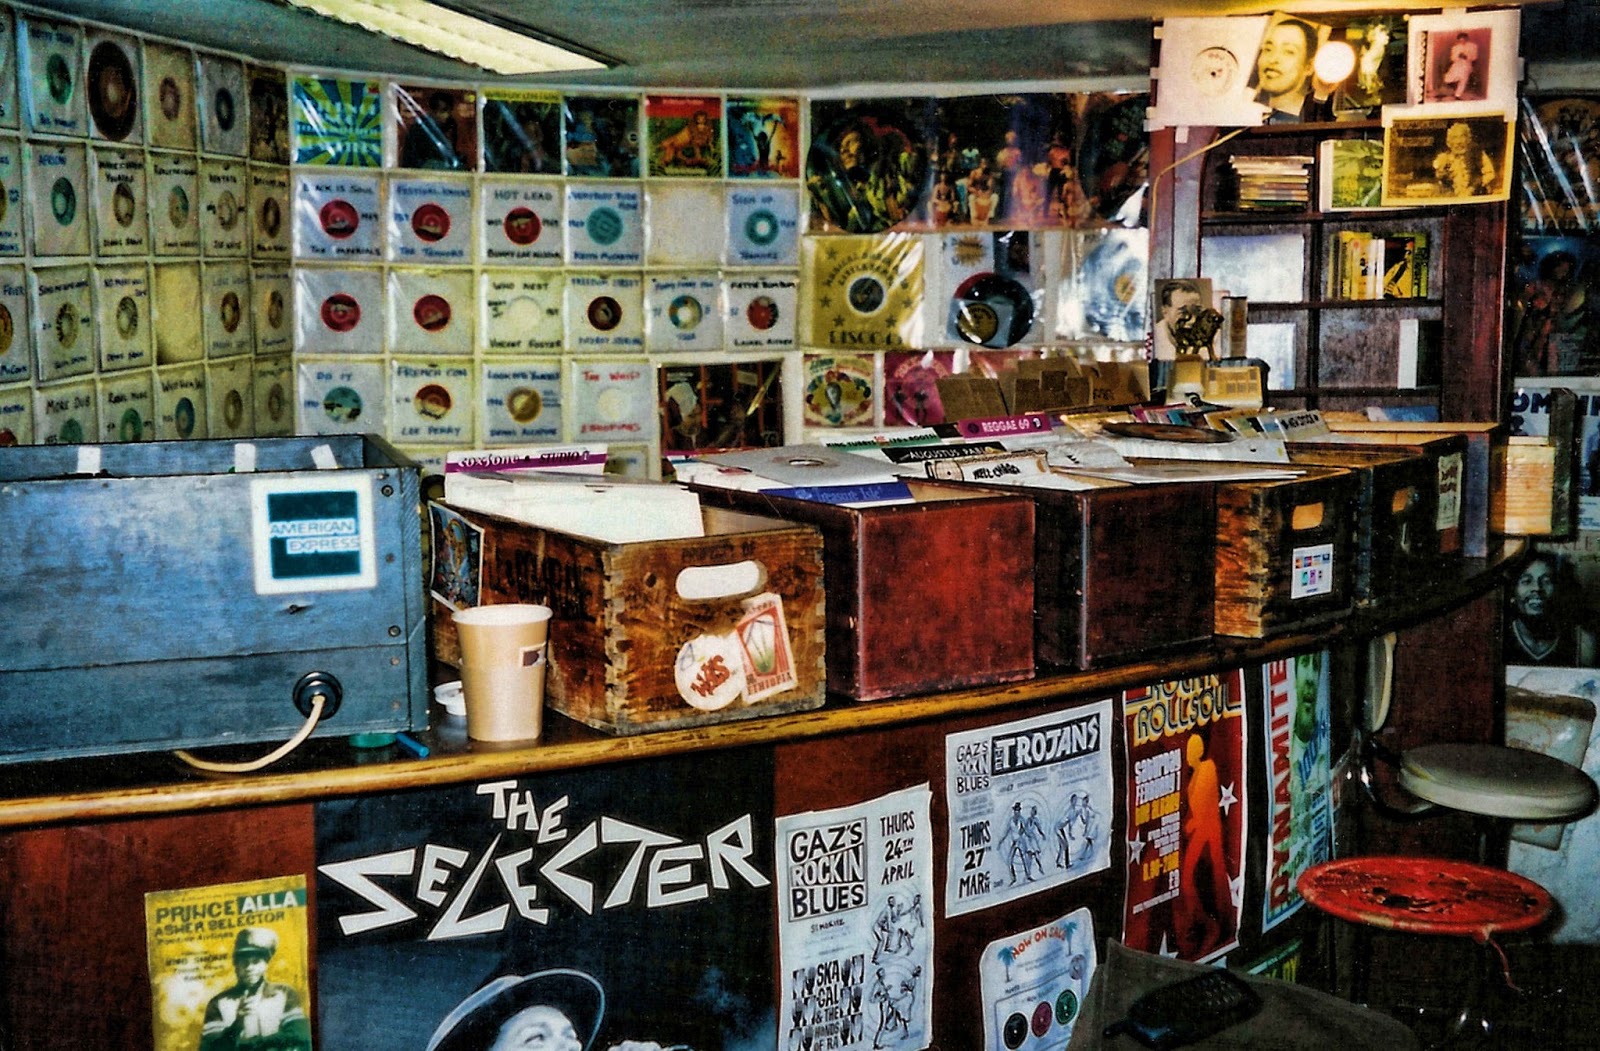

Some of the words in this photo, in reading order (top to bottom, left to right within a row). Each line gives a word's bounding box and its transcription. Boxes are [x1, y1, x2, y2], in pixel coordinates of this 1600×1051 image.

[494, 190, 519, 201] HOT
[524, 191, 553, 201] LEAD
[493, 282, 516, 291] WHO
[981, 419, 1018, 433] REGGAE
[1018, 418, 1030, 430] 69
[539, 451, 579, 465] STUDIO
[909, 448, 959, 461] AUGUSTUS
[269, 519, 355, 537] AMERICAN
[288, 537, 361, 552] EXPRESS
[995, 714, 1100, 769] TROJANS
[956, 775, 990, 794] BLUES
[1268, 659, 1293, 910] DYNAMITE
[476, 780, 569, 844] THE
[880, 810, 916, 837] THURS
[790, 822, 863, 864] GAZ'S
[959, 819, 992, 850] THURS
[317, 813, 772, 940] SELECTER
[790, 843, 865, 887] ROCKIN
[881, 860, 915, 886] APRIL
[958, 870, 991, 899] MARCH
[155, 900, 236, 924] PRINCE
[240, 890, 298, 915] ALLA
[791, 884, 865, 919] BLUES
[154, 921, 205, 938] ASHER
[208, 911, 286, 931] SELECTOR
[1012, 935, 1033, 960] NOW
[1034, 927, 1048, 943] ON
[816, 959, 841, 987] SKA
[816, 983, 840, 1009] GAL
[824, 1006, 840, 1020] THE
